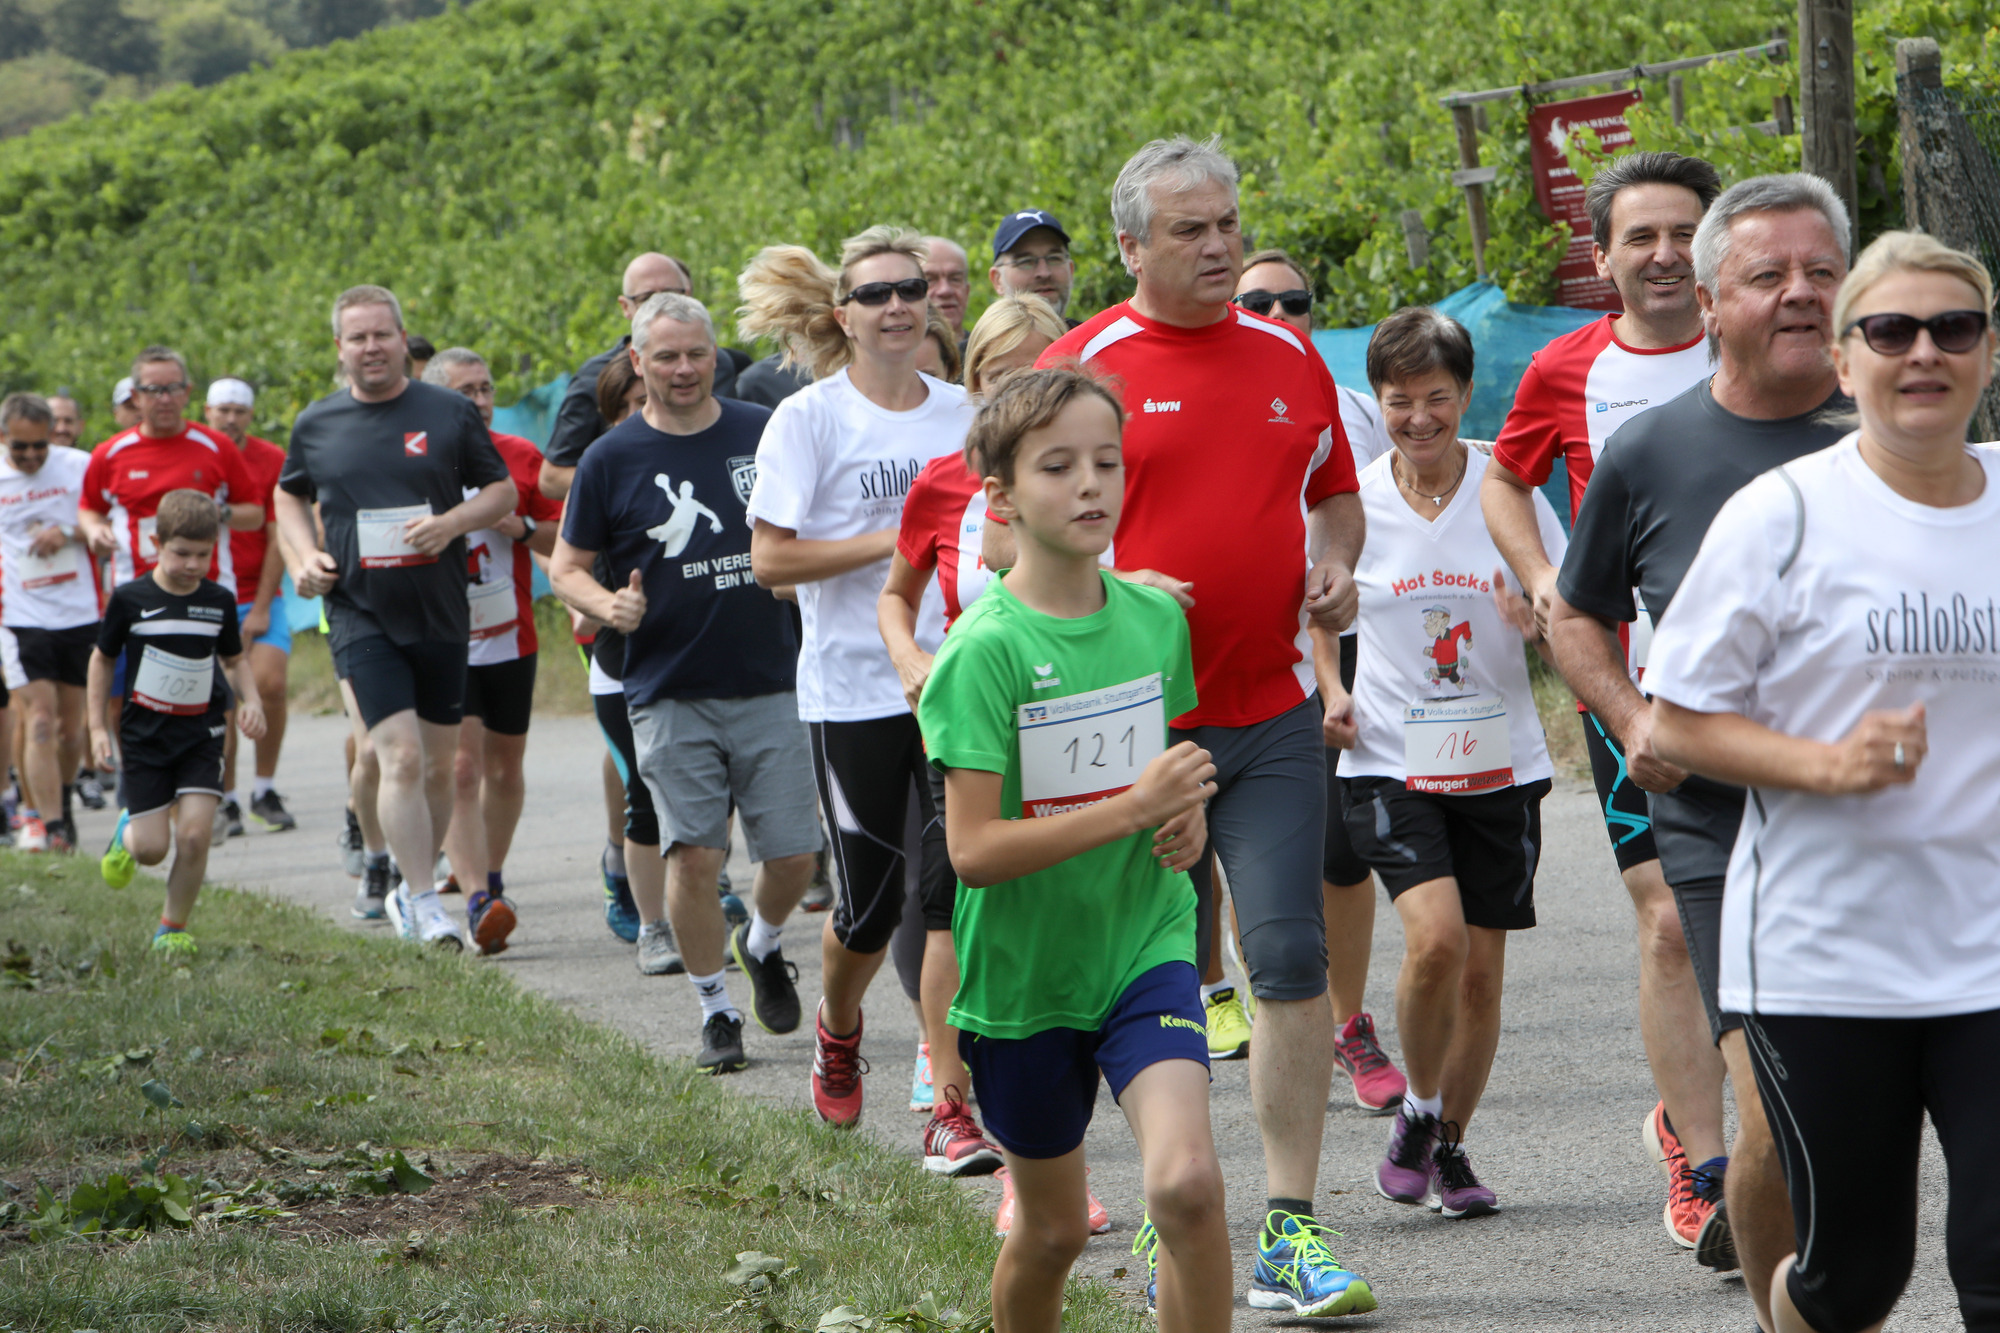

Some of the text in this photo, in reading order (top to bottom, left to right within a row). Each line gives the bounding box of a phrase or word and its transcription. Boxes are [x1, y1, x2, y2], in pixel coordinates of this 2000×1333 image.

[860, 458, 925, 499] schloß
[682, 553, 752, 579] EIN VERE
[715, 572, 740, 590] EIN
[1391, 567, 1490, 597] Hot Socks
[1866, 590, 2000, 654] schloßst
[1049, 698, 1102, 716] Volksbank
[1427, 707, 1468, 717] Volksbank
[1063, 724, 1135, 774] 121
[1435, 730, 1478, 759] 16
